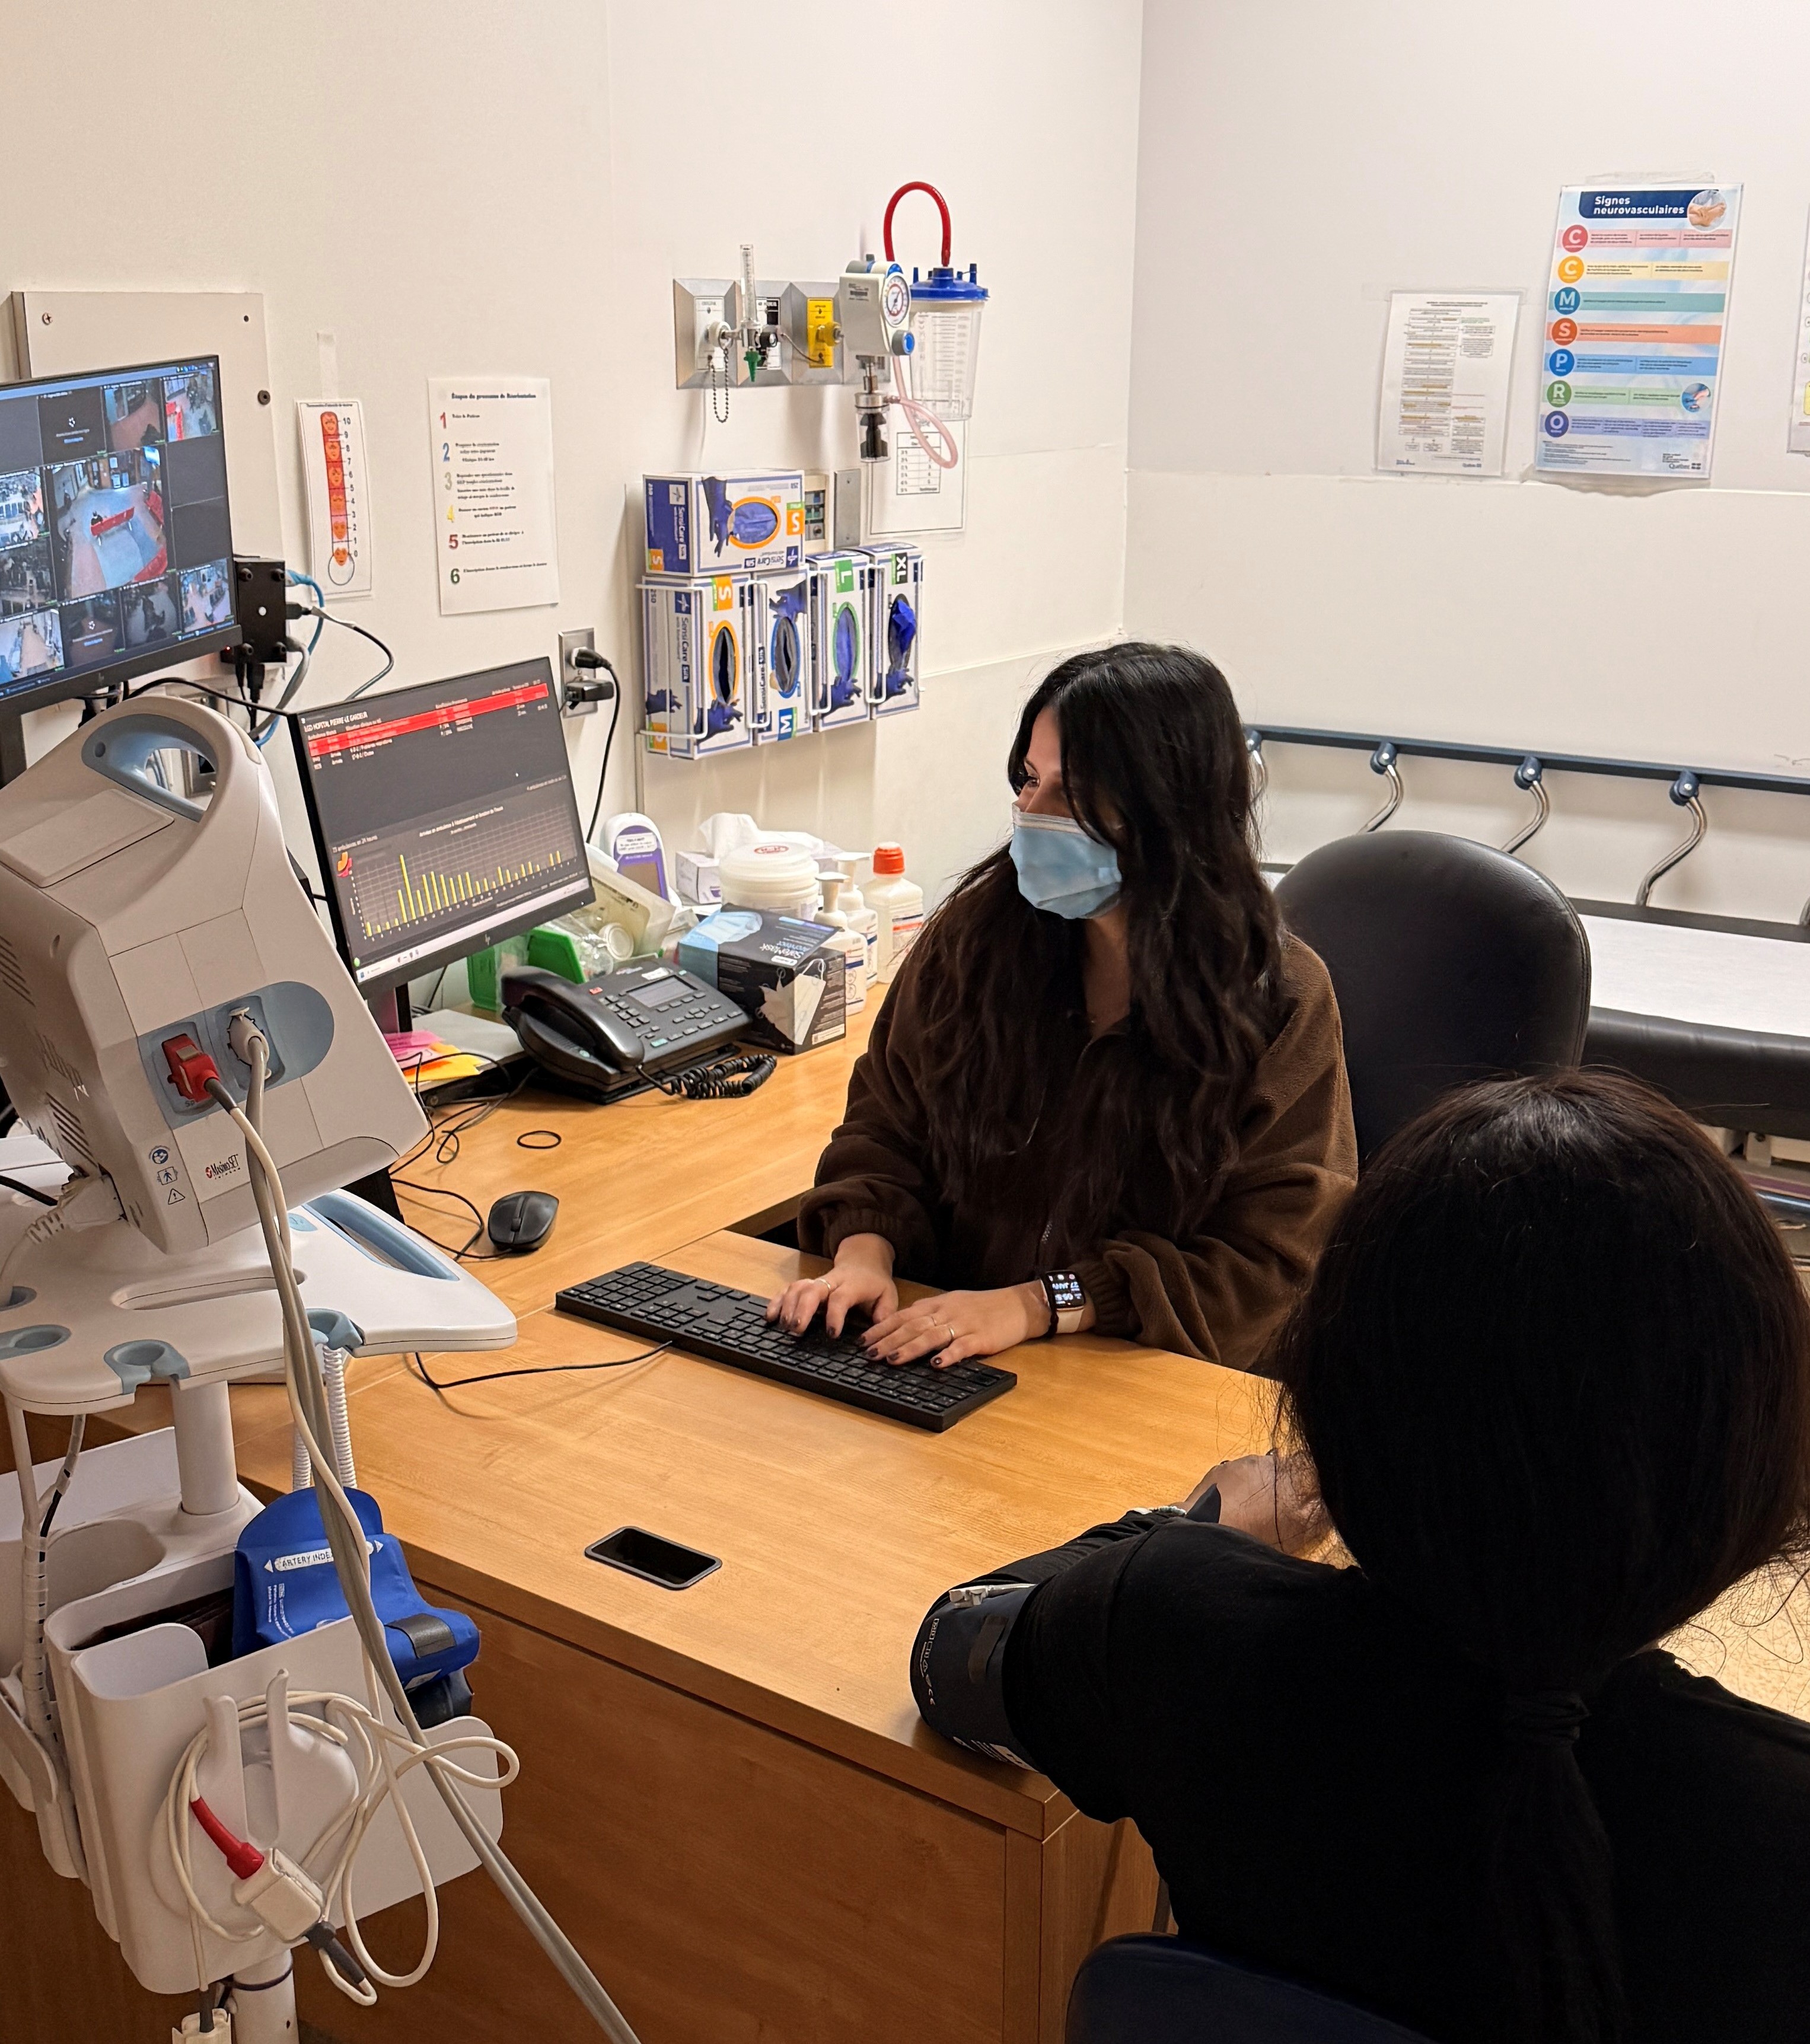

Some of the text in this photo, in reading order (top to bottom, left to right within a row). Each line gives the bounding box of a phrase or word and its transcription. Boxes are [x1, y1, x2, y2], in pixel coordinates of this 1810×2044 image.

[1594, 196, 1630, 207] Signes
[1593, 205, 1685, 215] neurovasculaires
[1569, 229, 1582, 244] C
[1564, 260, 1578, 275] C
[1559, 291, 1576, 306] M
[1558, 322, 1571, 337] S
[1556, 353, 1568, 368] P
[1553, 384, 1565, 398] R
[440, 412, 447, 429] 1
[1550, 414, 1564, 429] O
[443, 442, 450, 462] 2
[445, 472, 452, 491] 3
[447, 505, 455, 523] 4
[792, 512, 800, 532] S
[448, 534, 458, 550] 5
[652, 556, 662, 565] S
[757, 556, 785, 566] SensiCare
[450, 567, 460, 585] 6
[841, 570, 852, 583] L
[896, 556, 907, 582] XL
[718, 586, 732, 601] S
[681, 617, 689, 662] SensiCare
[780, 715, 793, 734] M
[760, 943, 805, 959] SafeMask
[228, 1154, 238, 1168] SET
[282, 1551, 333, 1567] ARTERY INDE
